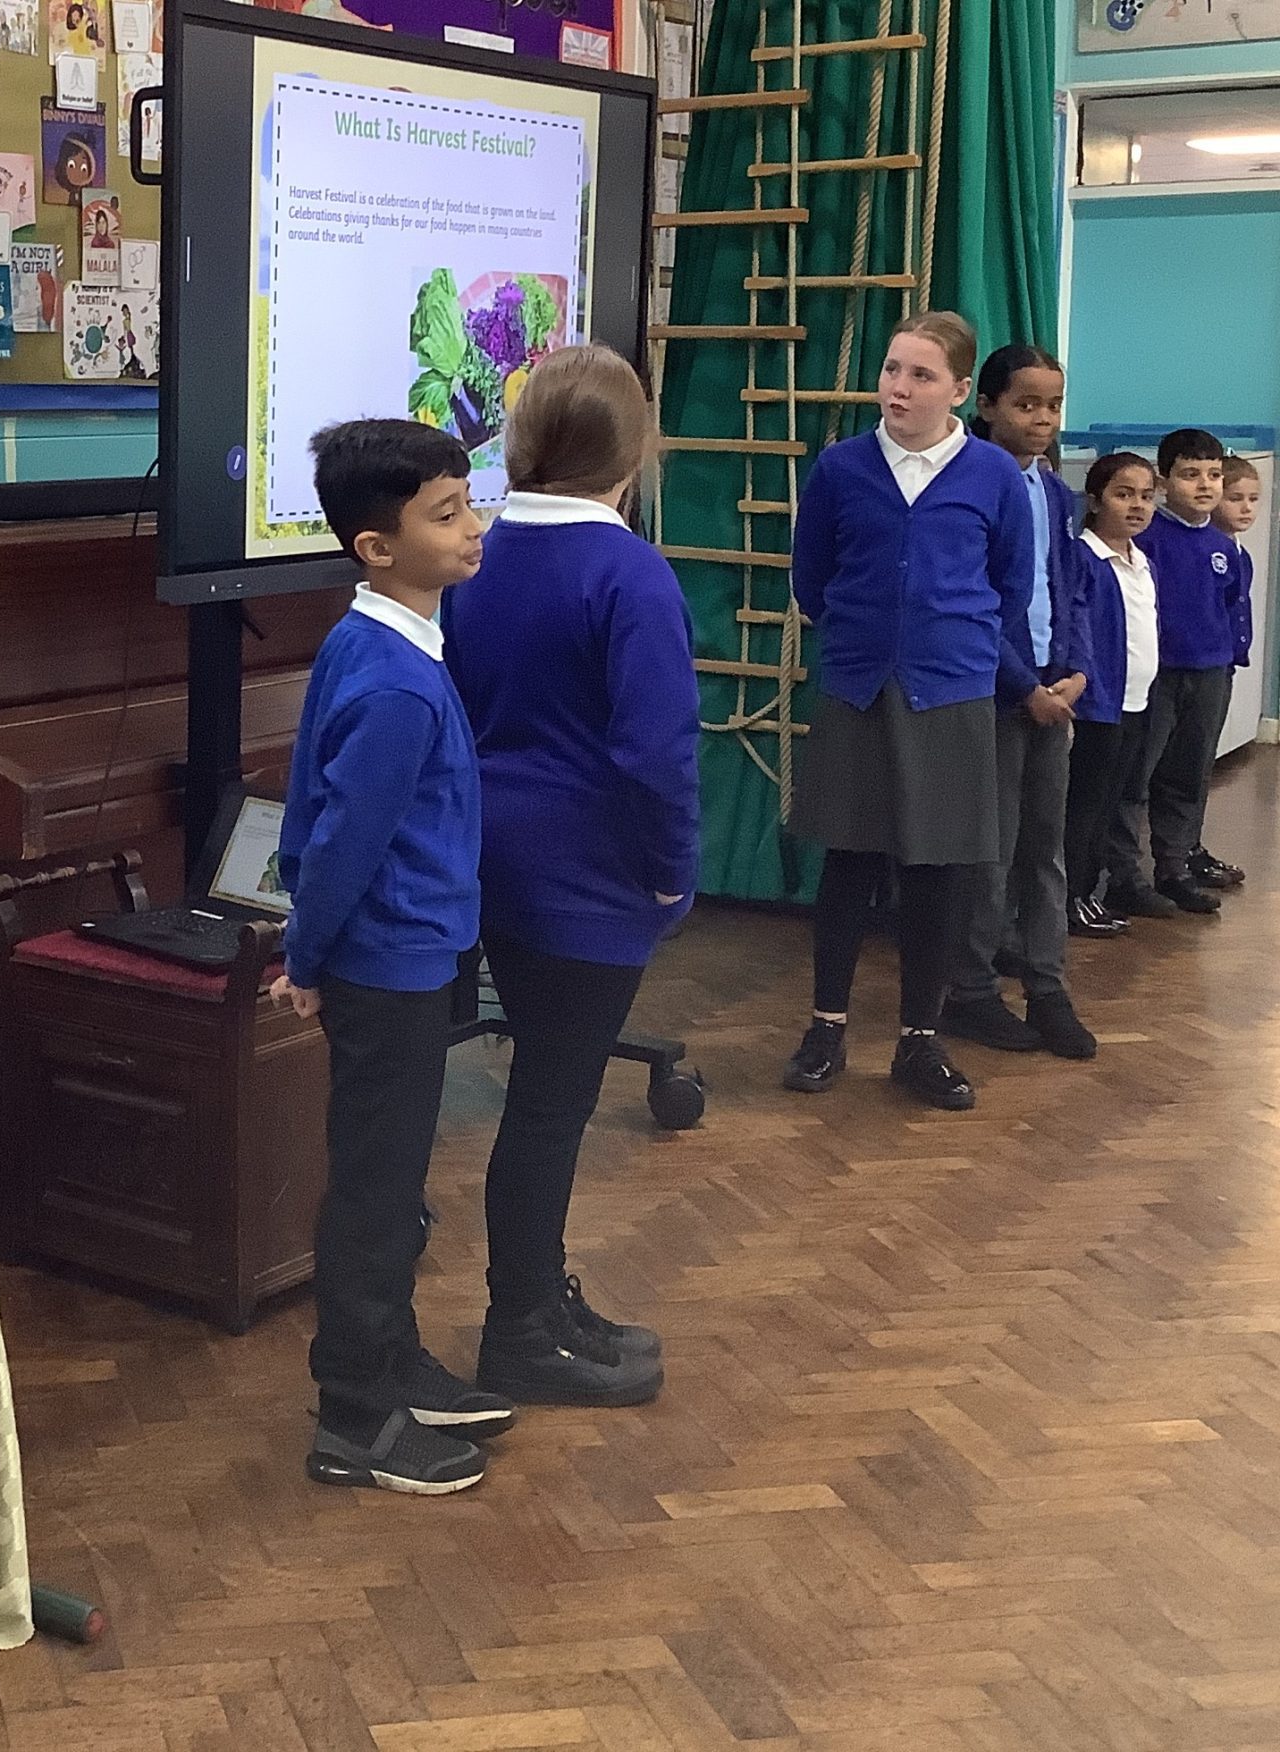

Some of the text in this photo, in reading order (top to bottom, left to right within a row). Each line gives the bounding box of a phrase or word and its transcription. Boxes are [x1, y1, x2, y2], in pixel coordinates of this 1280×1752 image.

[334, 110, 537, 159] What Is Harvest Festival?
[289, 185, 323, 201] Harvest
[324, 188, 358, 204] Festival
[376, 193, 420, 210] celebration
[432, 197, 444, 212] the
[445, 199, 463, 215] food
[464, 201, 481, 215] that
[490, 206, 514, 220] grown
[525, 207, 538, 220] the
[288, 206, 342, 223] Celebrations
[344, 210, 370, 228] giving
[372, 212, 400, 228] thanks
[429, 216, 447, 233] food
[449, 218, 476, 235] happen
[488, 224, 508, 239] many
[510, 225, 542, 239] countries
[288, 228, 365, 244] around the world.
[28, 246, 51, 260] NOT
[11, 261, 53, 275] A GIRL
[87, 259, 117, 272] MALALA
